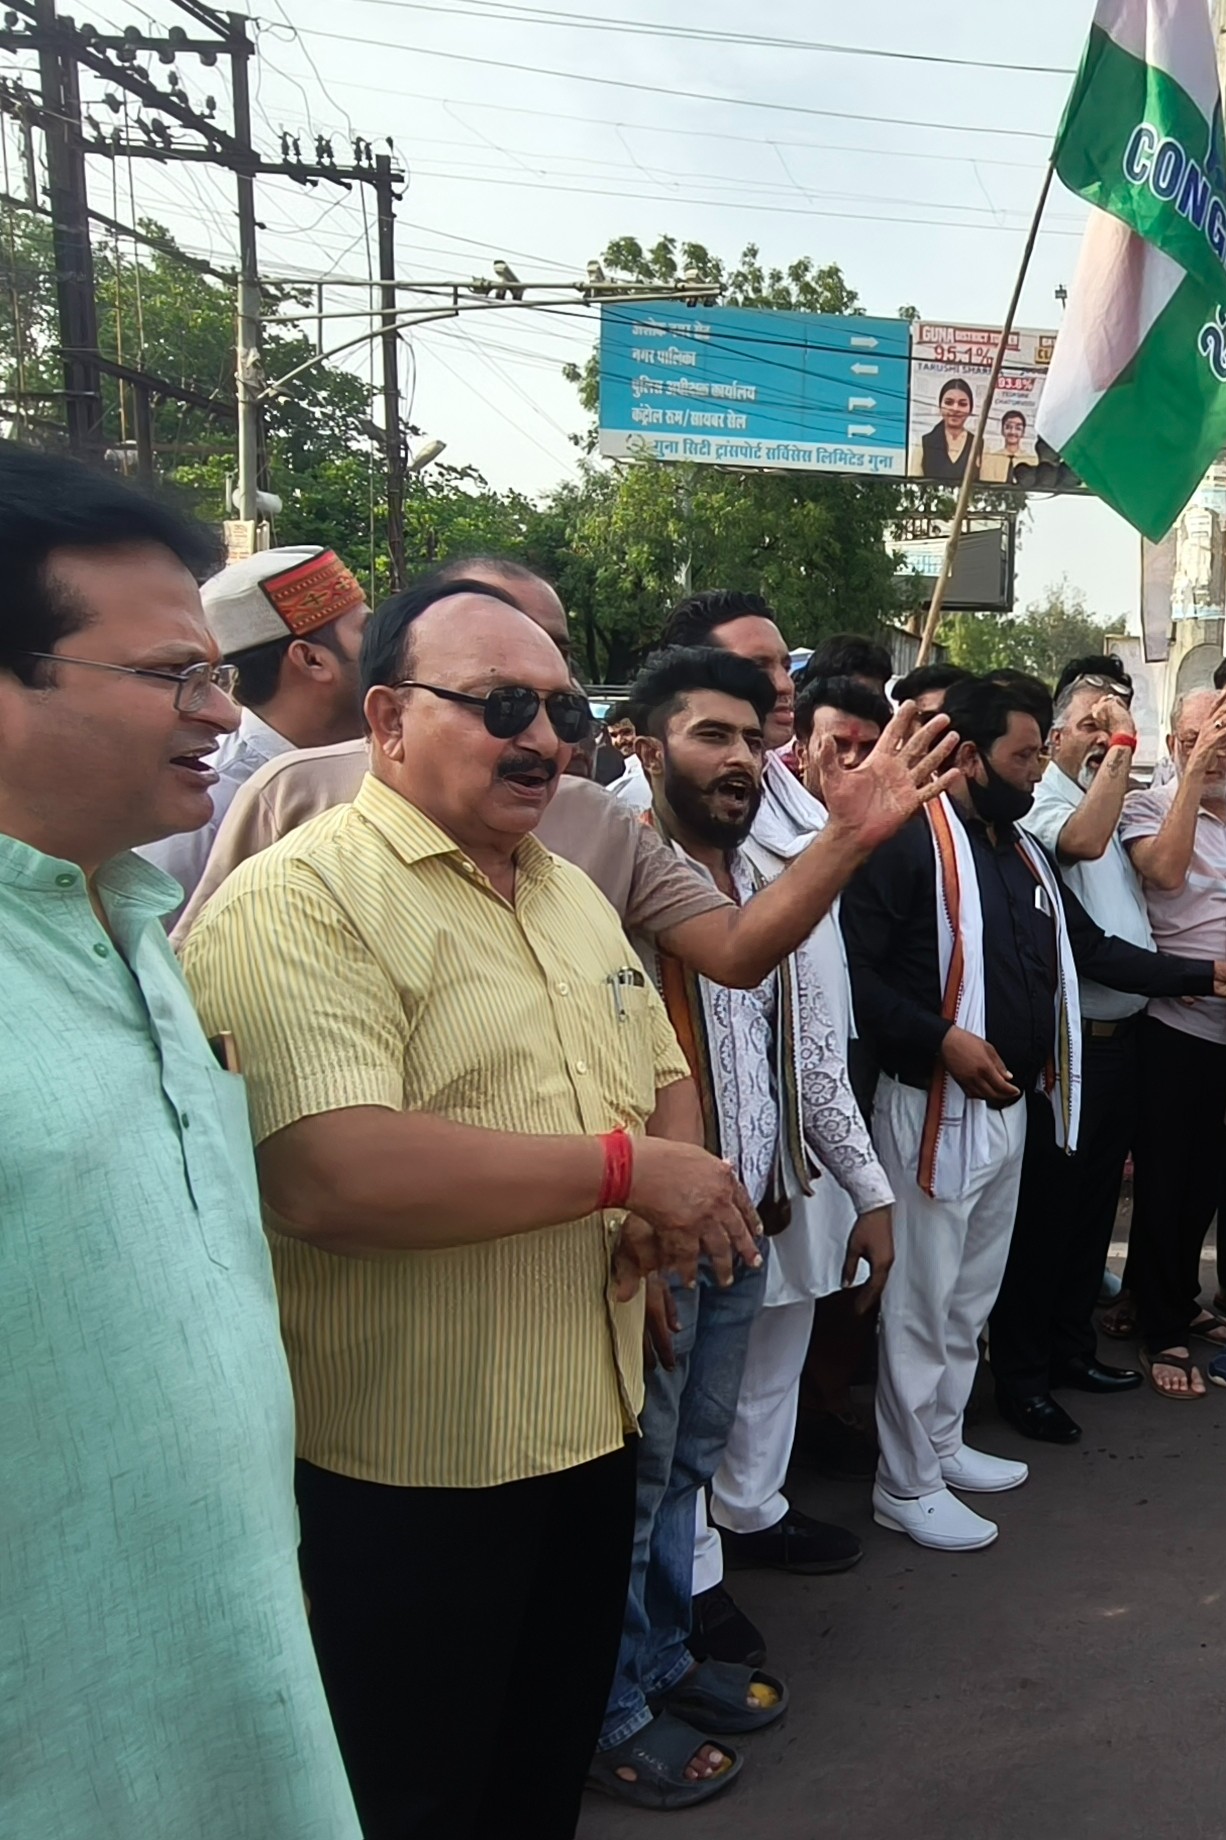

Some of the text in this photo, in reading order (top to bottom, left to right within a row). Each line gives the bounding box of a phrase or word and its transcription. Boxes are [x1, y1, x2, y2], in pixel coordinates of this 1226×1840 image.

[922, 325, 954, 344] GUNA
[631, 346, 696, 366] नगर पालिका
[631, 375, 663, 398] पुलिस
[710, 380, 756, 401] कार्यालय
[654, 437, 894, 472] गुना सिटी ट्रांसपोर्ट सर्विसेस लिमिटेड गुना
